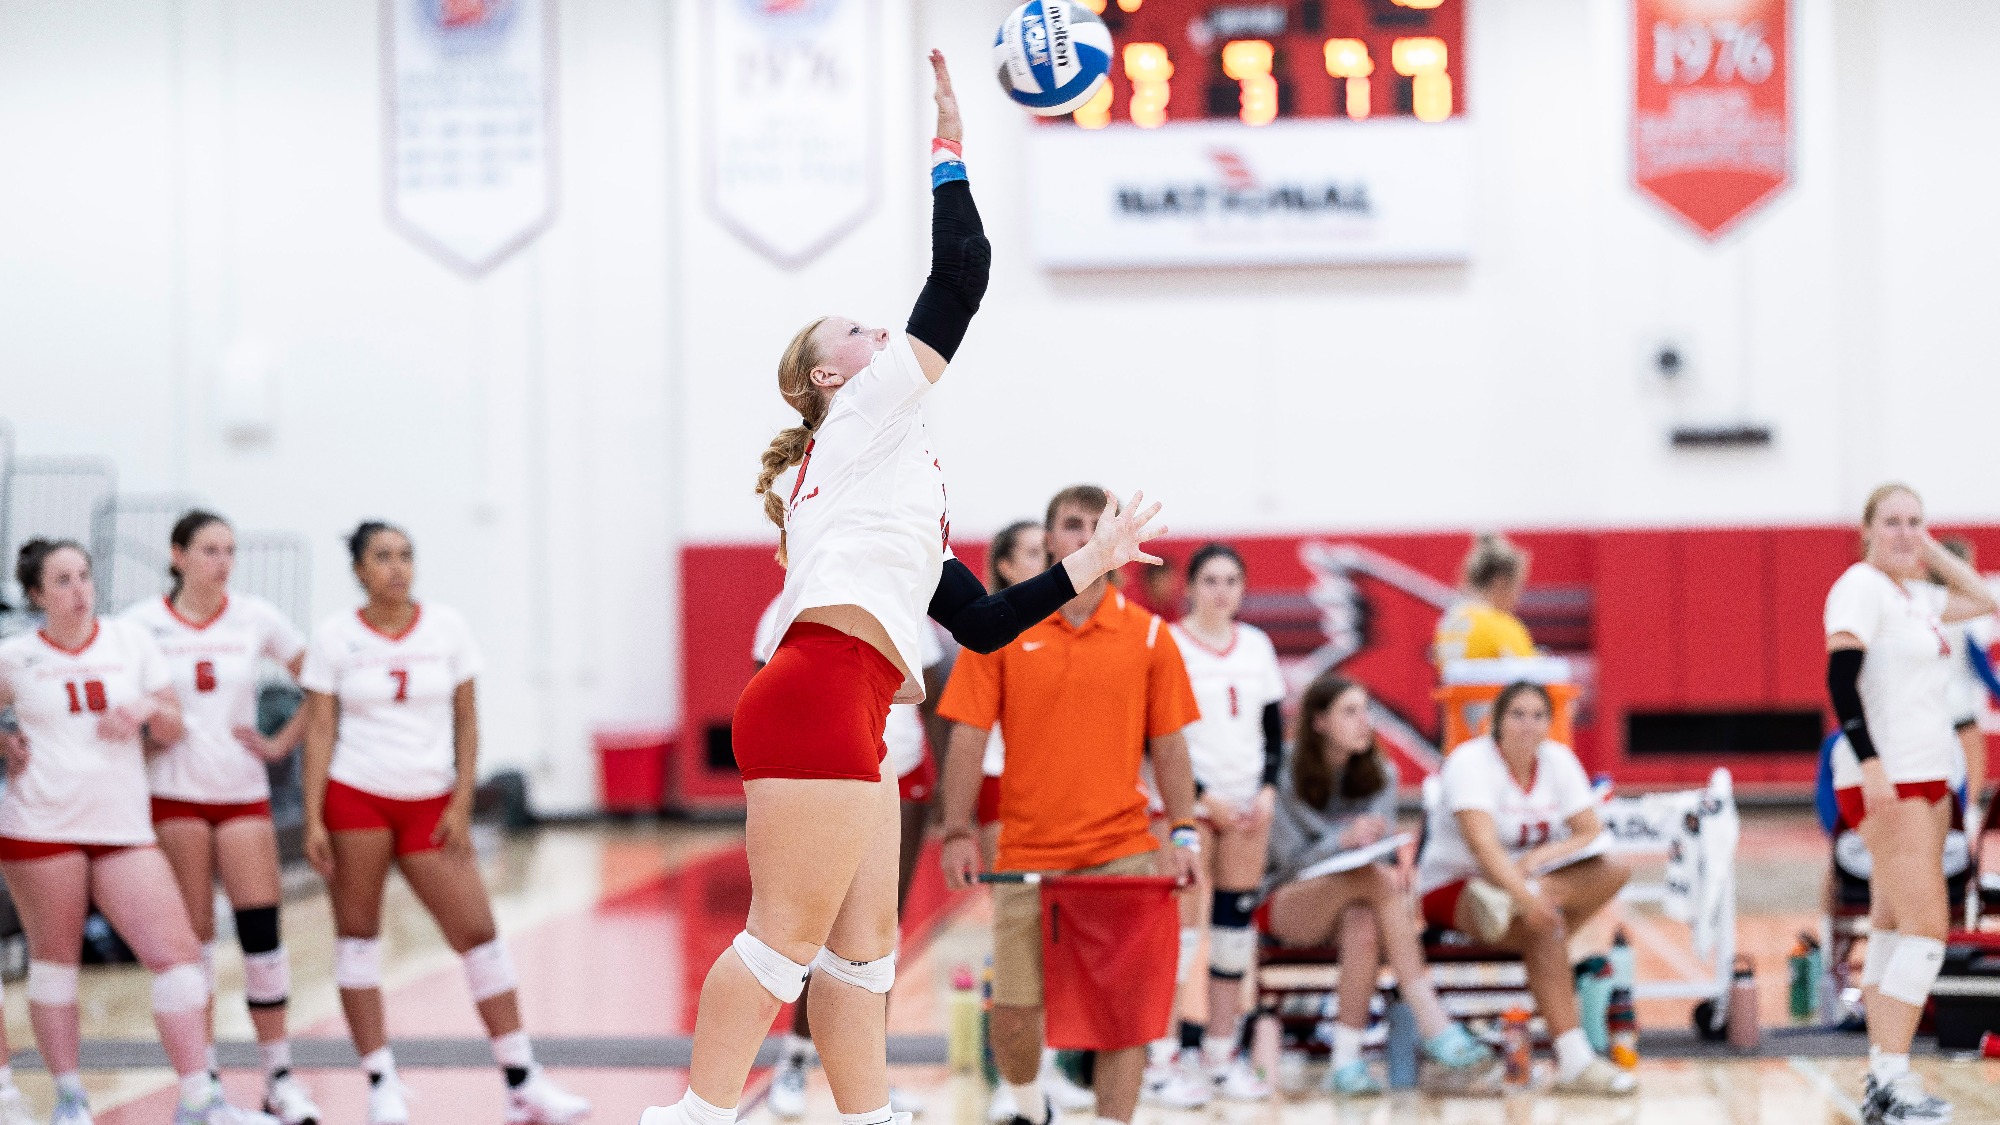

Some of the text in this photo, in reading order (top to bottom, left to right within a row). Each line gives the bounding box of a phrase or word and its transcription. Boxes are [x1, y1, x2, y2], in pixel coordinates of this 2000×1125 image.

[1048, 6, 1070, 67] molten
[1652, 20, 1775, 84] 1976
[194, 660, 216, 692] 6
[388, 669, 408, 703] 7
[1228, 685, 1239, 718] 1
